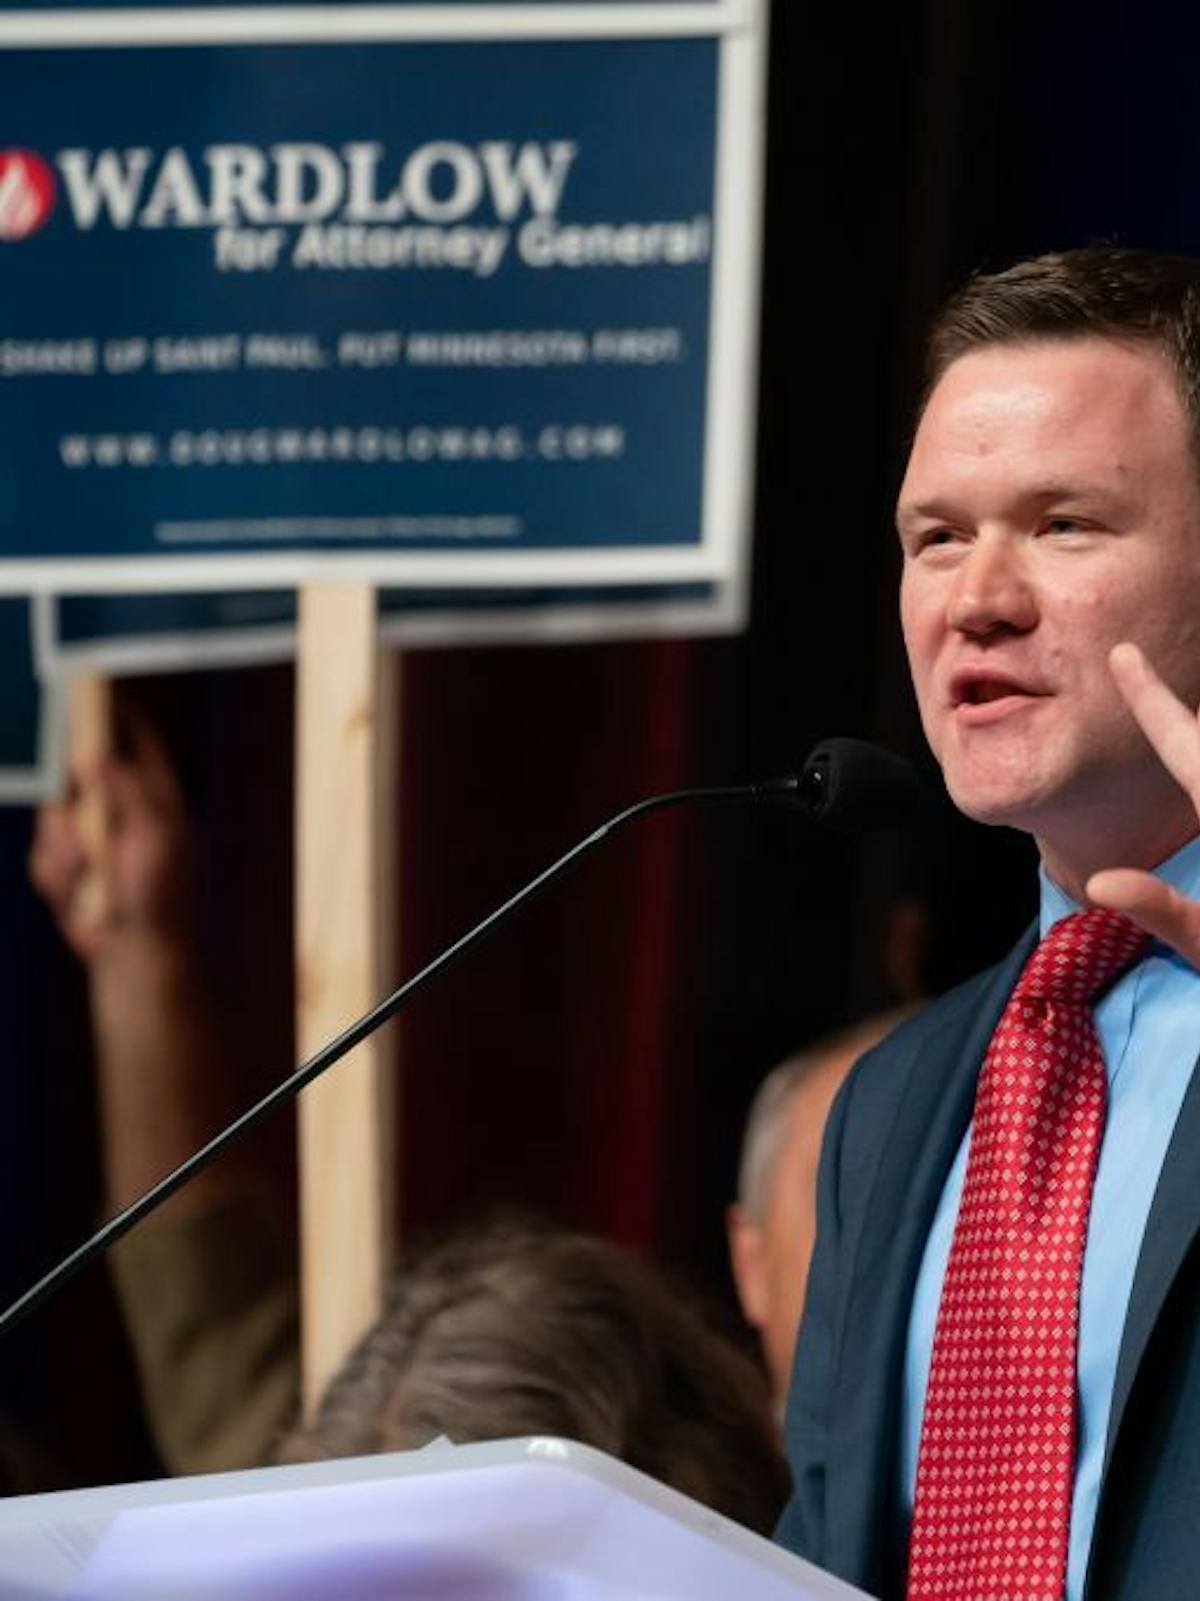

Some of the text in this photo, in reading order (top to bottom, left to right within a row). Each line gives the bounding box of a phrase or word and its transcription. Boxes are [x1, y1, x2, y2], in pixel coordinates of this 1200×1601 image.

[58, 140, 577, 229] WARDLOW
[213, 216, 711, 277] for Attorney General
[103, 335, 149, 374] UP
